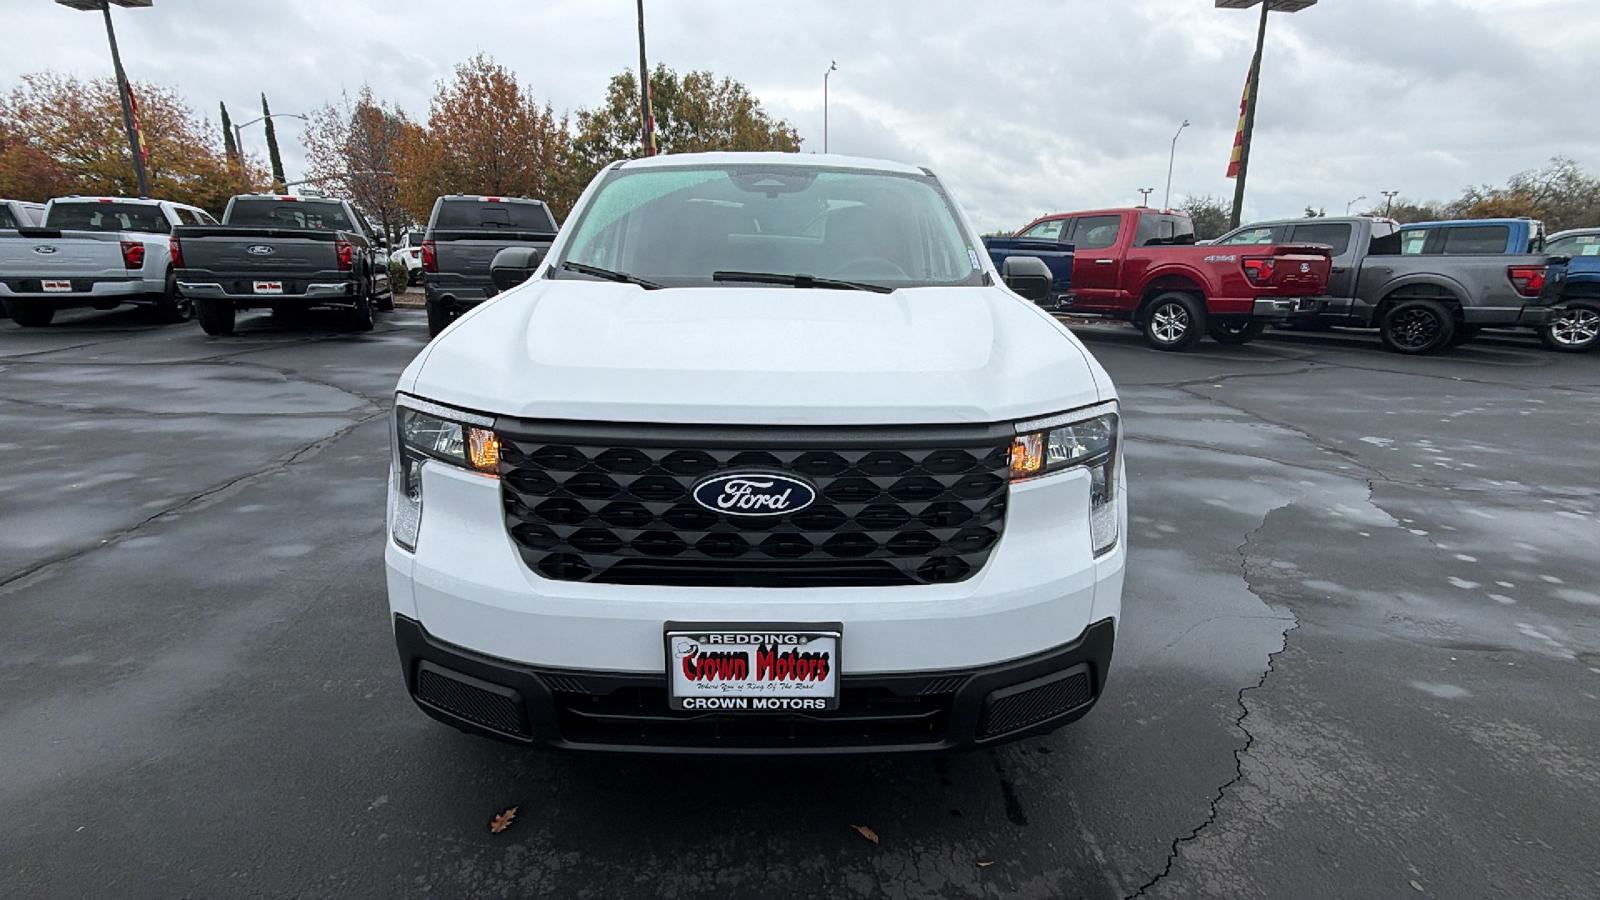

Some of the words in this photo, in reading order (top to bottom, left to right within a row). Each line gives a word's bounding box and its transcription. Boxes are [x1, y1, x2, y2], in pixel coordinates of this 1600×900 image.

[717, 479, 793, 509] Ford
[709, 634, 798, 645] REDDING
[682, 651, 749, 682] Crown
[756, 646, 830, 682] Motors
[779, 682, 792, 690] The
[682, 697, 748, 709] CROWN
[752, 697, 826, 709] MOTORS
